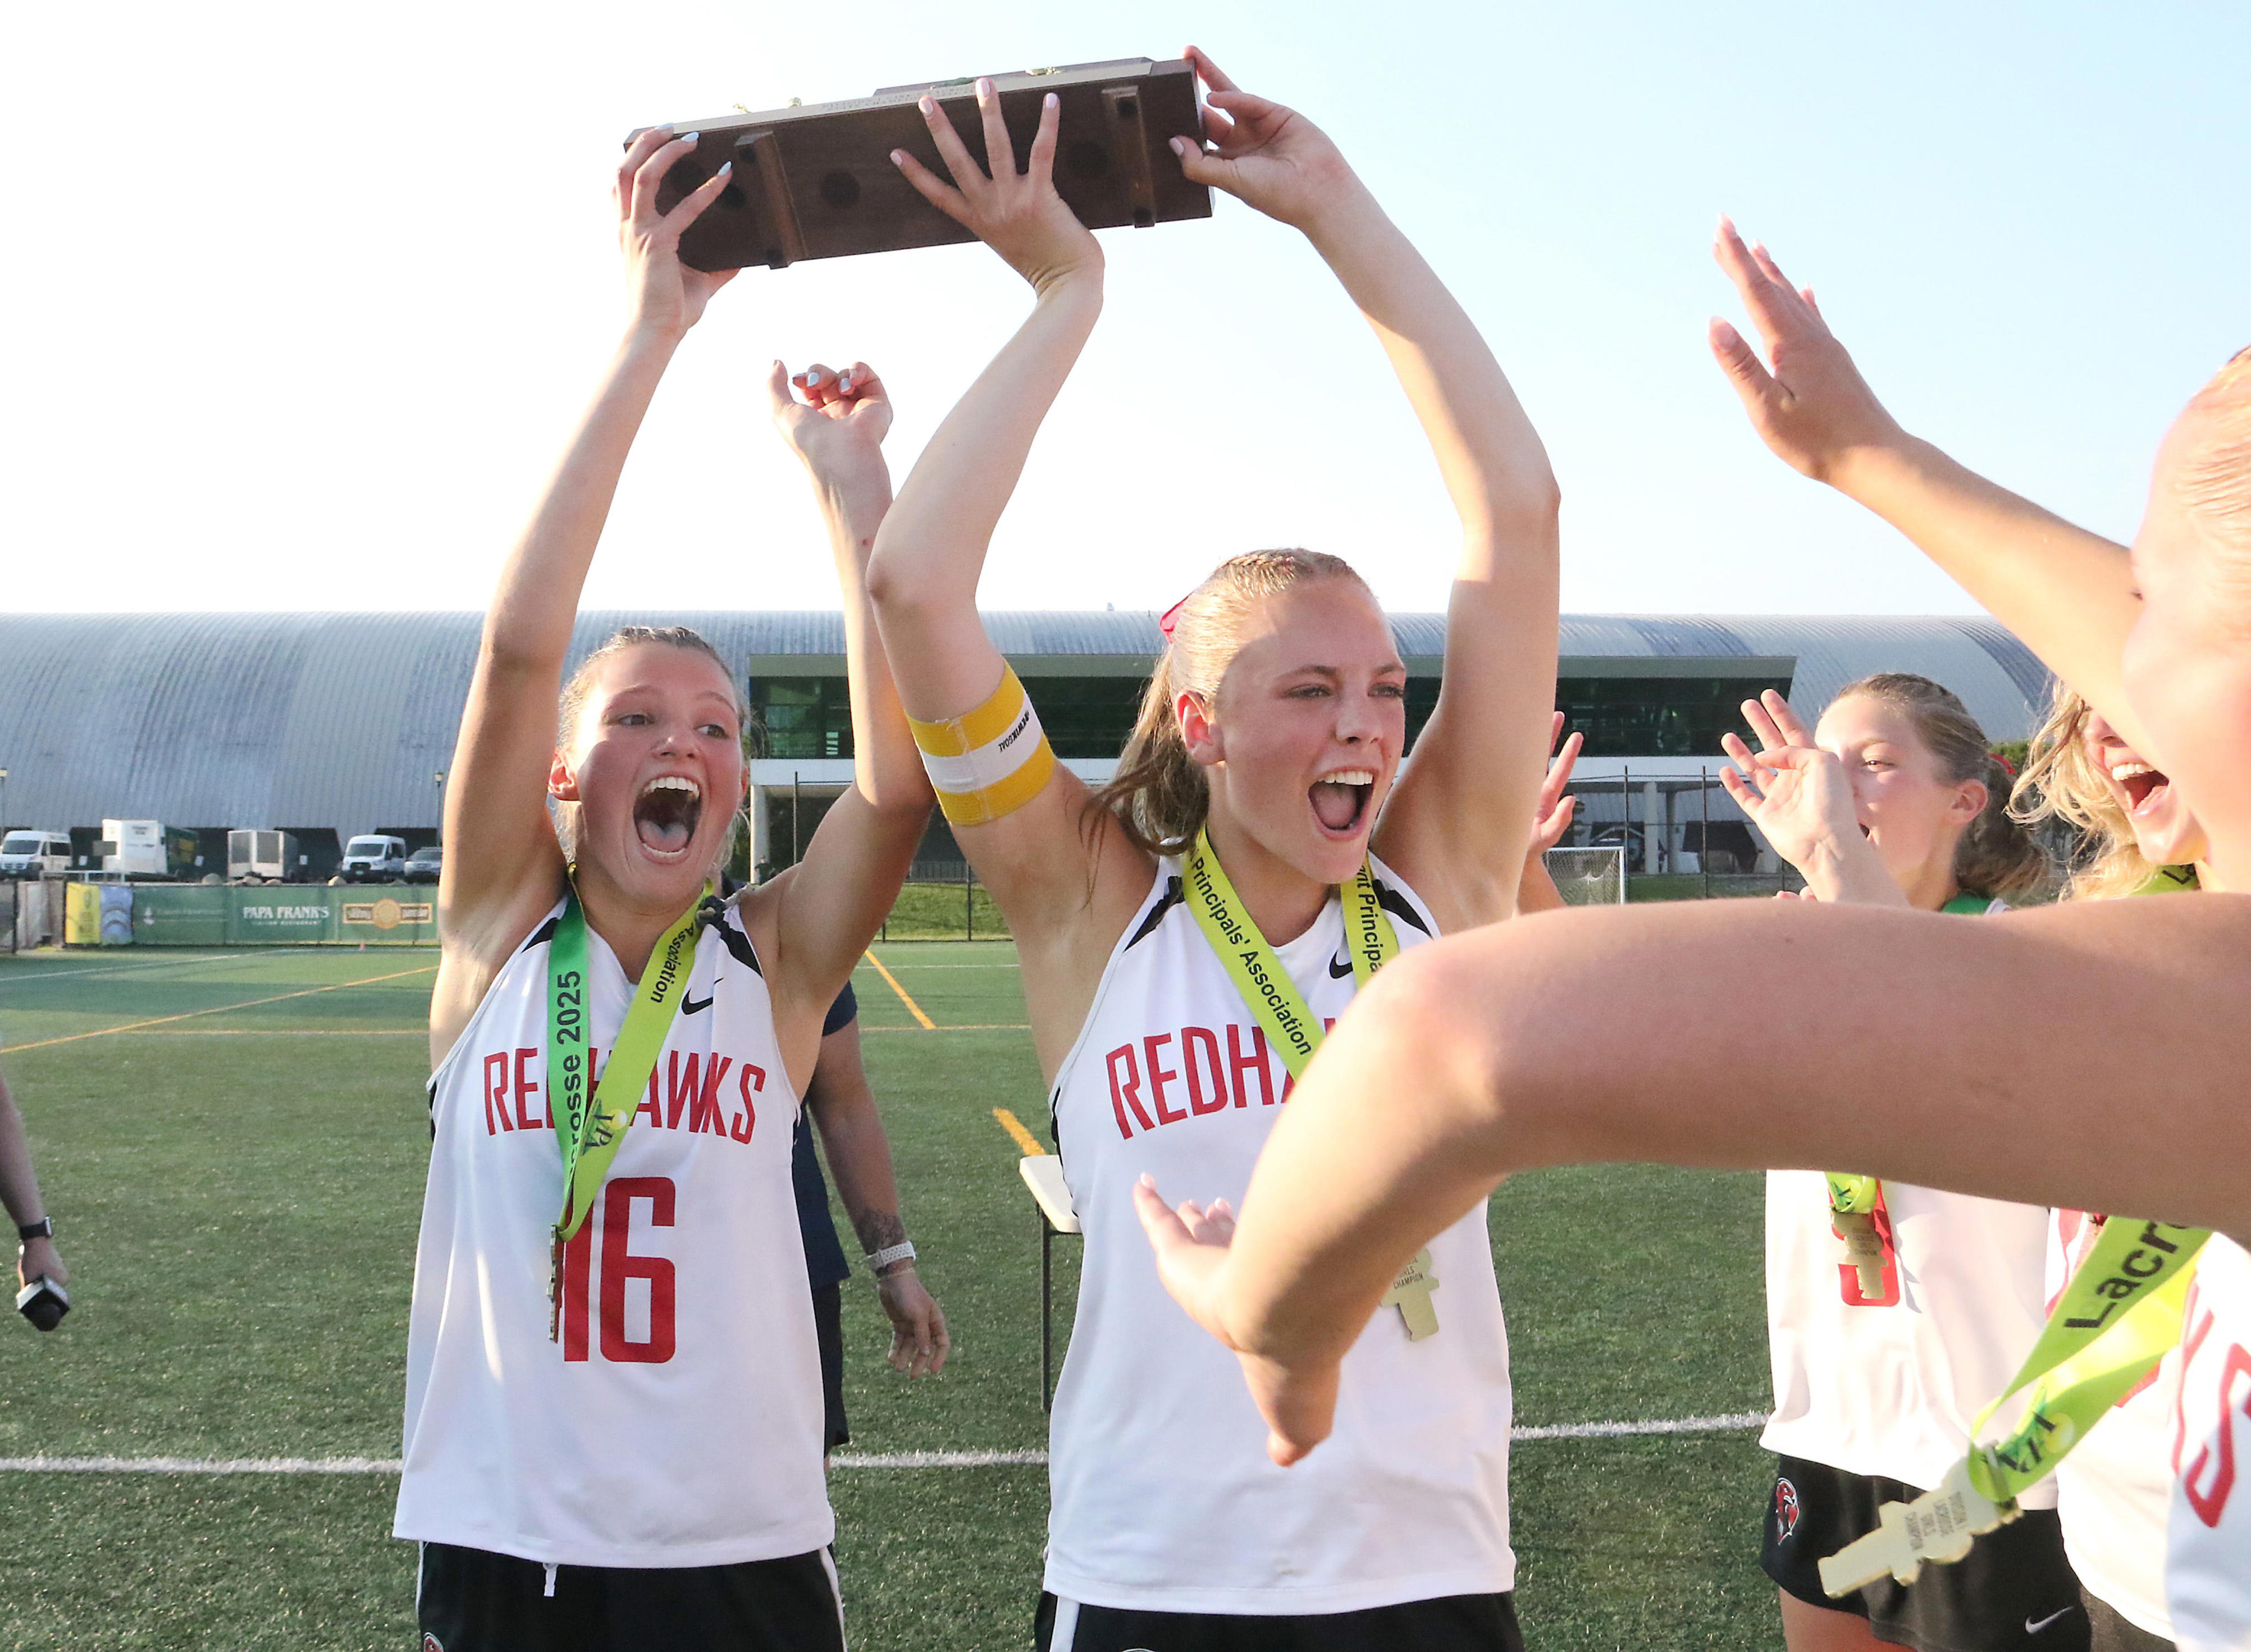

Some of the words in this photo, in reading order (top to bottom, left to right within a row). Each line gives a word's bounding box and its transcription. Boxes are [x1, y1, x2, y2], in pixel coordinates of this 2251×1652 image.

[243, 906, 273, 918] PAPA
[277, 905, 330, 919] FRANK'S
[556, 970, 582, 1046] 2025
[650, 922, 695, 1003] Association
[1239, 949, 1312, 1055] Association
[483, 1047, 766, 1145] REHAWKS
[1106, 1018, 1336, 1140] REDH
[564, 1177, 676, 1363] 16
[1392, 1272, 1424, 1289] CHAMPION
[2063, 1221, 2188, 1329] Lacr
